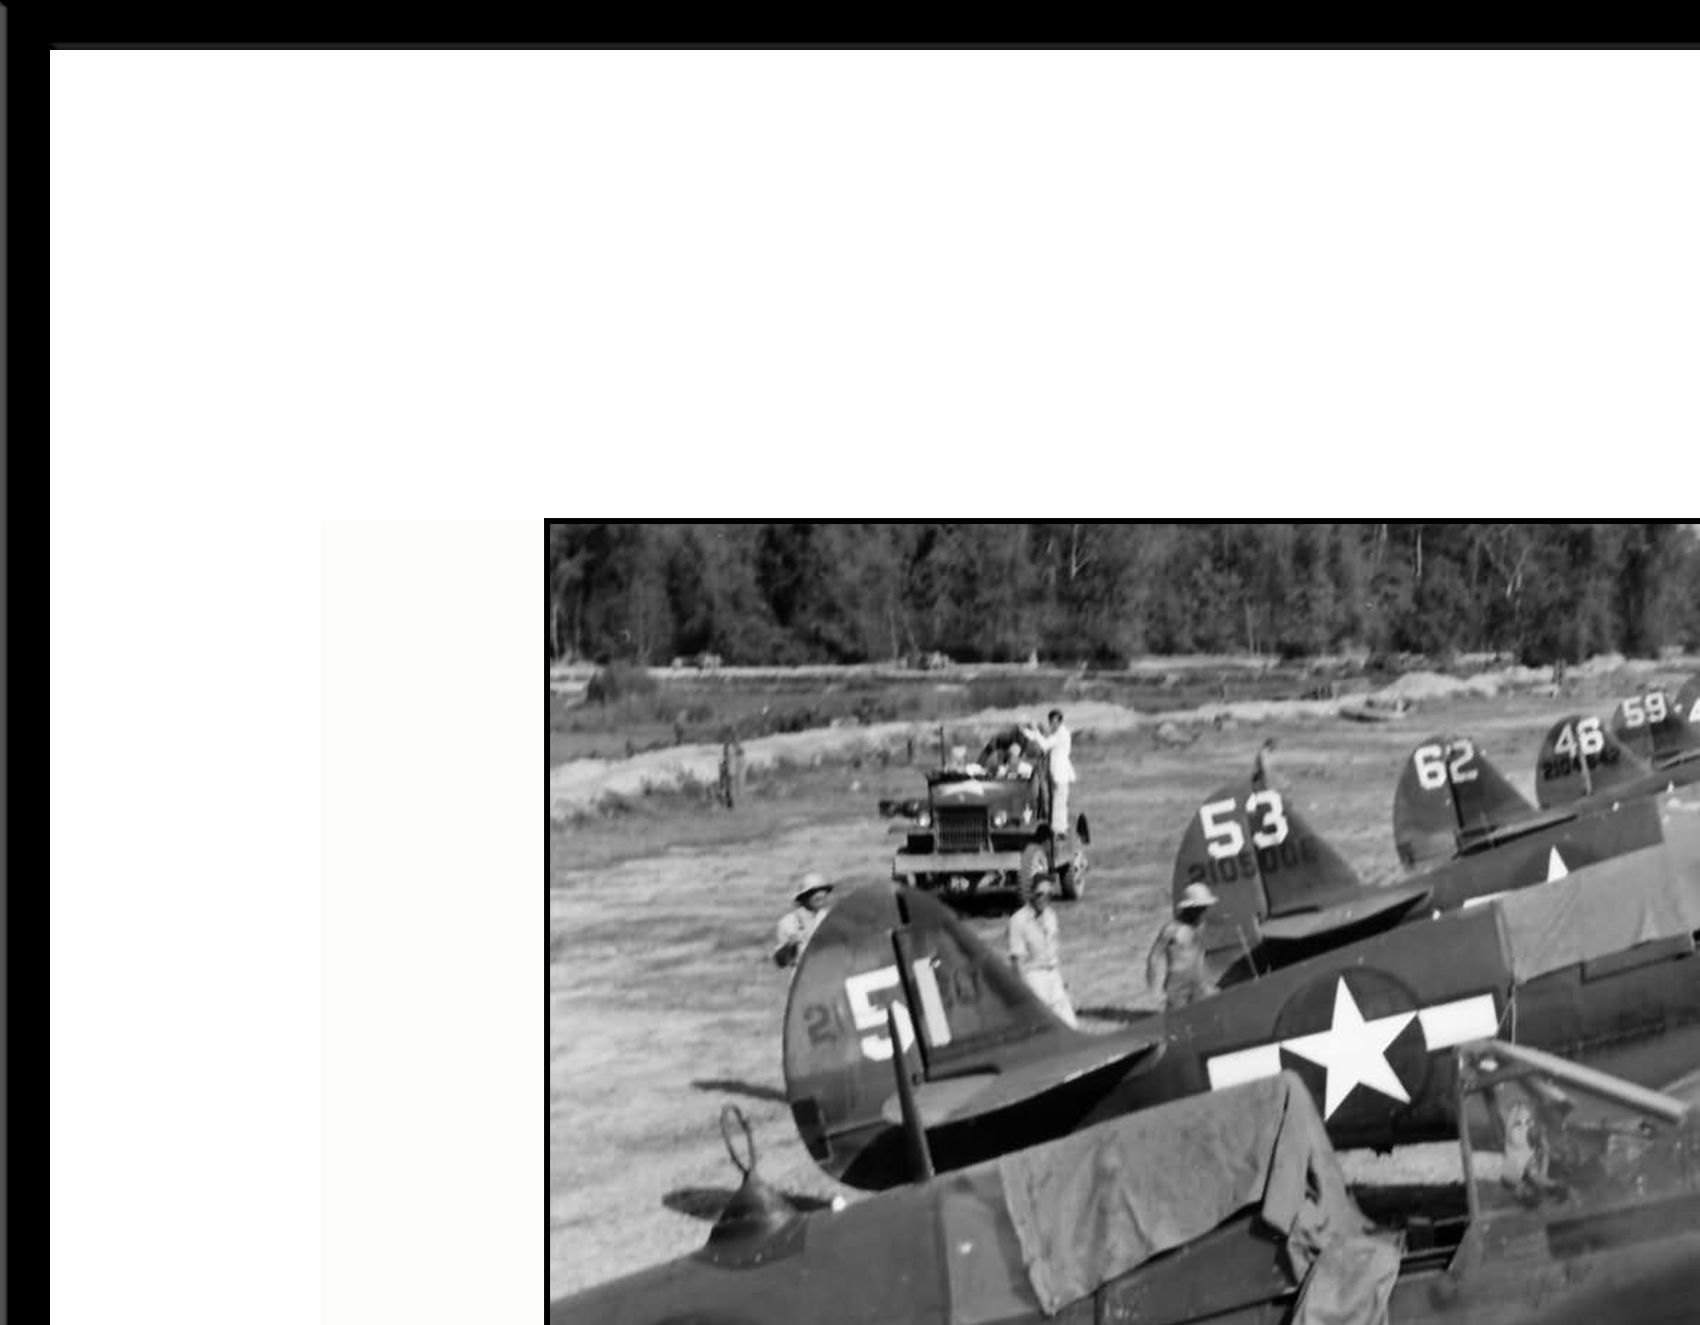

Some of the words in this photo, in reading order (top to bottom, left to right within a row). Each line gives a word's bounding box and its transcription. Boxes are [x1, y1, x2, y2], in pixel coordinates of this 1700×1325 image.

[1622, 691, 1667, 729] 59
[1554, 716, 1604, 759] 46
[1414, 739, 1479, 790] 62
[1200, 789, 1289, 859] 53
[845, 956, 952, 1061] 51
